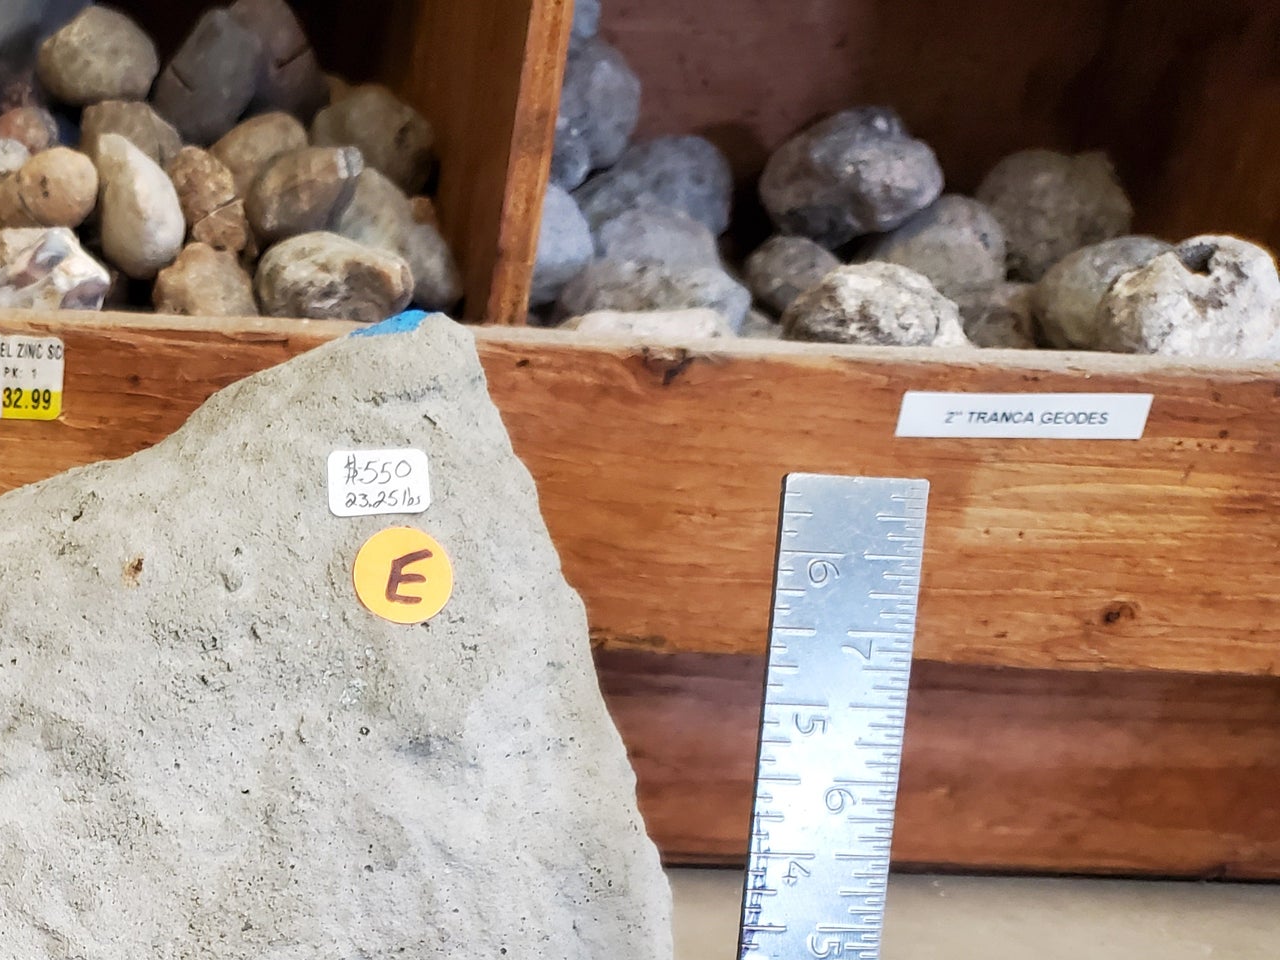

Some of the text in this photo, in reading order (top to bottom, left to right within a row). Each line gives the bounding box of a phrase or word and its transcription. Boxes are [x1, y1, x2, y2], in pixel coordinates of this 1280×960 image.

[2, 387, 52, 410] 32.99
[967, 411, 1035, 424] TRANCA
[1039, 411, 1110, 425] GEODES
[384, 548, 434, 605] E
[794, 712, 827, 735] 5
[807, 934, 842, 958] 5
